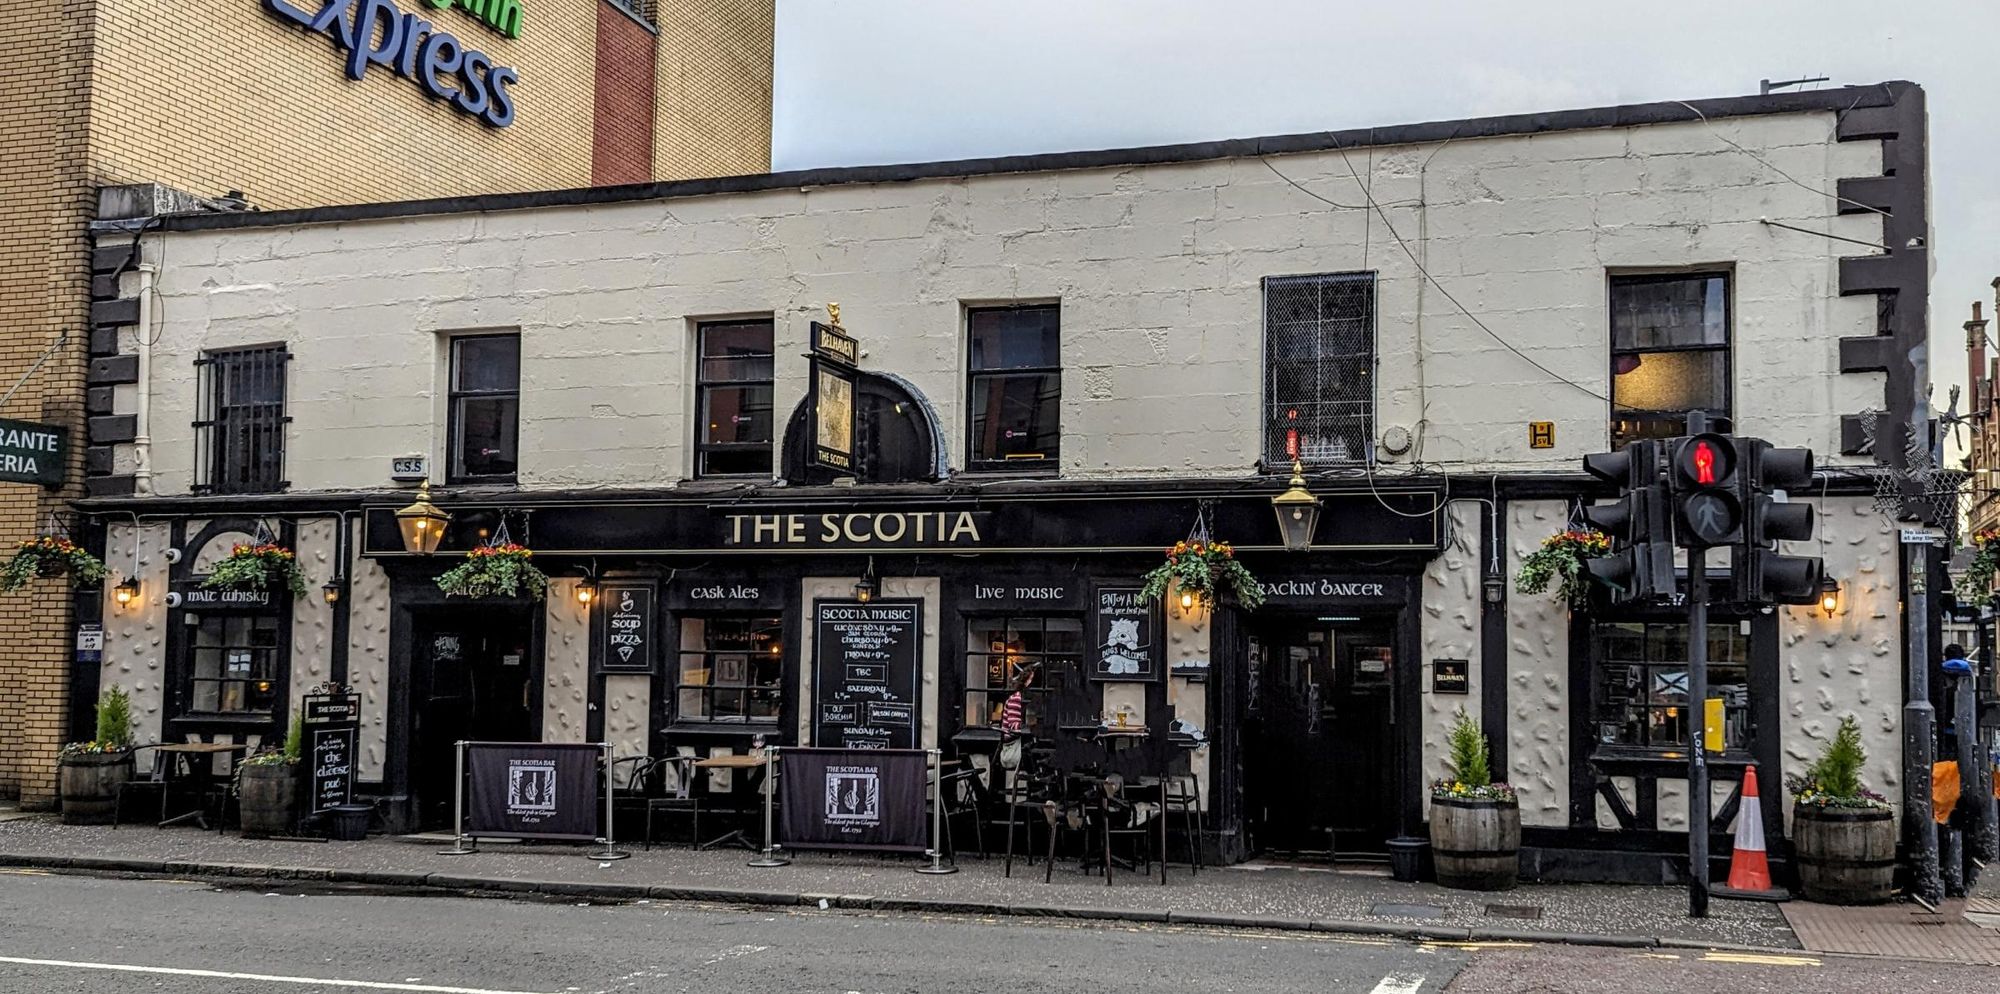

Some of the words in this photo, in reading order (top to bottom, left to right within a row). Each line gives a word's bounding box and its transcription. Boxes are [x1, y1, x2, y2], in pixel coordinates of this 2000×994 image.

[821, 330, 854, 360] BELHAVEN
[818, 450, 830, 463] THE
[830, 453, 850, 468] SCOTIA
[725, 514, 806, 543] THE
[820, 511, 981, 542] SCOTIA
[856, 668, 872, 676] TBC
